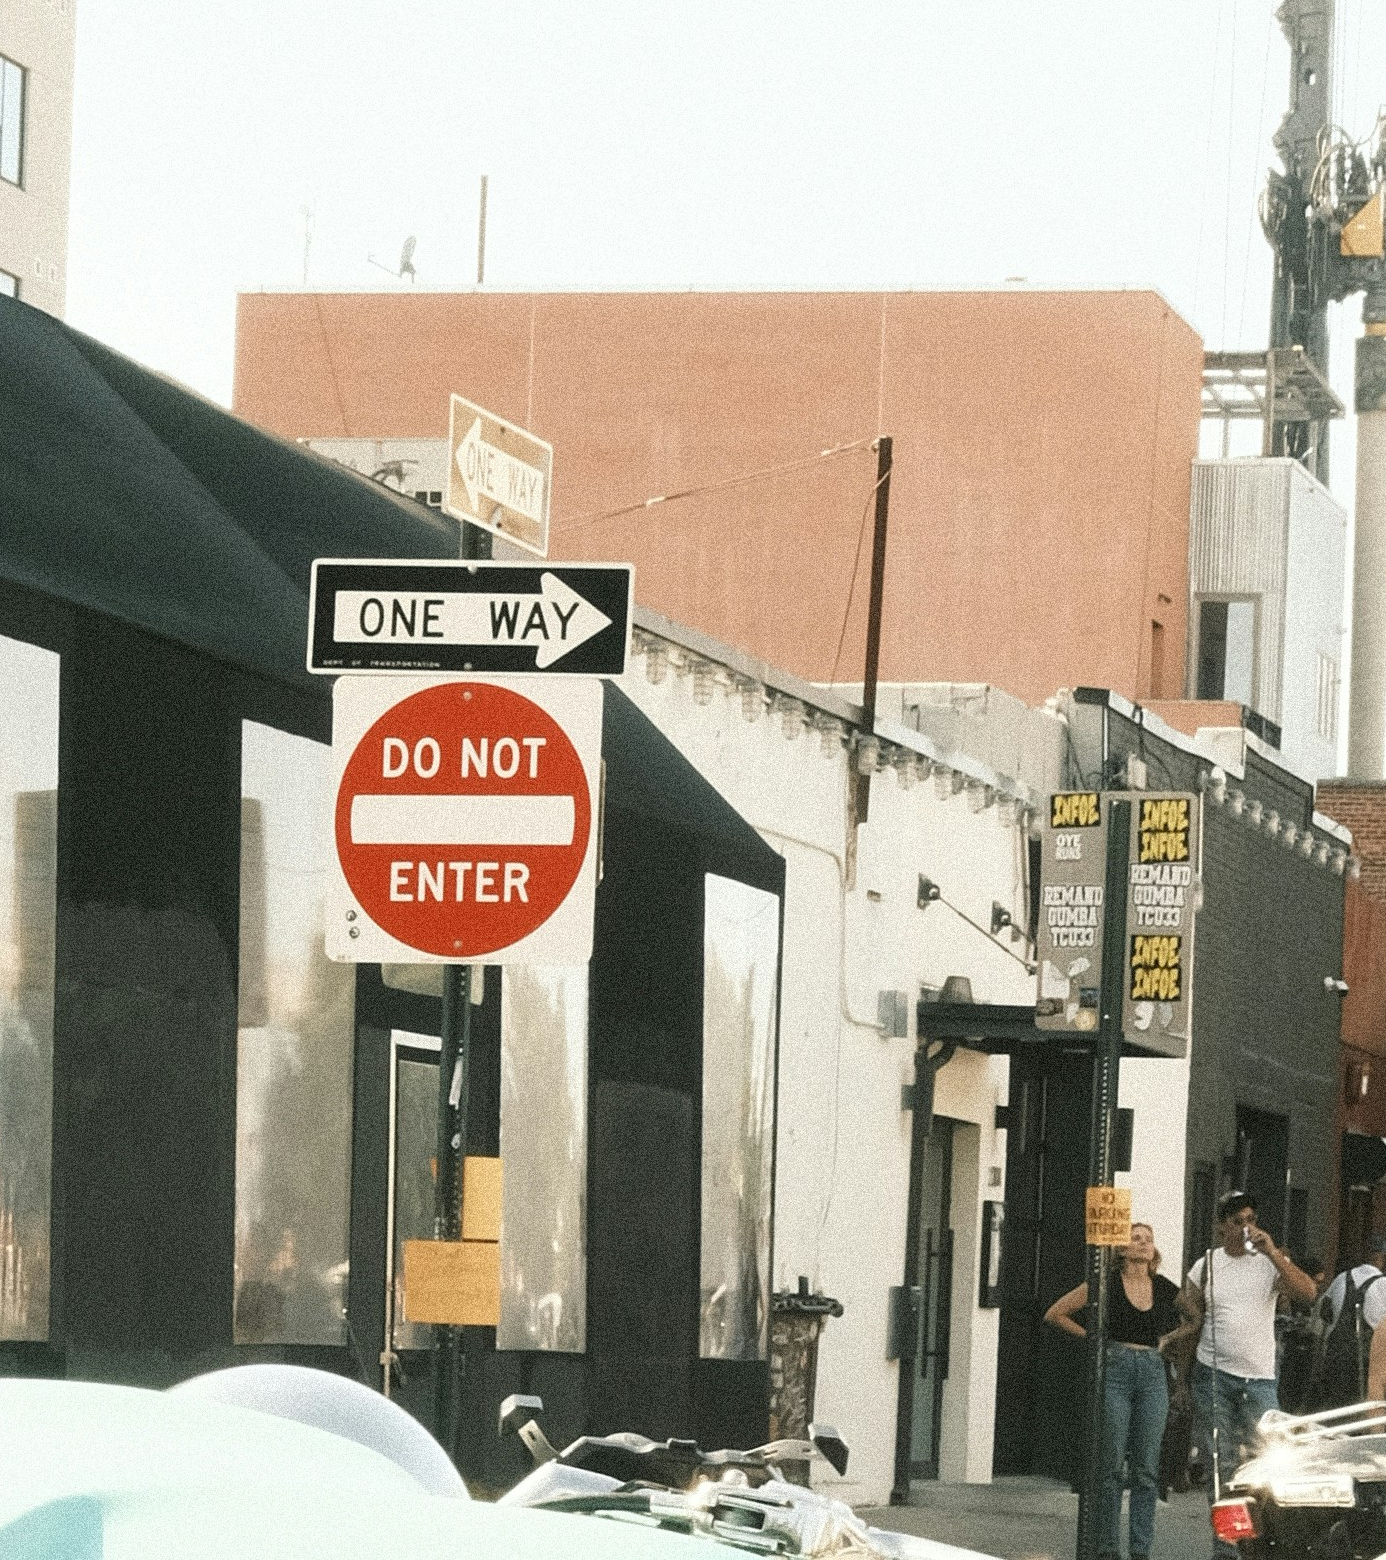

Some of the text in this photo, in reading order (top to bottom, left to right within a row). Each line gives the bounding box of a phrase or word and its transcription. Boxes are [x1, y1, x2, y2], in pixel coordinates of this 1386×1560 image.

[466, 441, 538, 508] ONE WAY
[359, 597, 580, 641] ONE WAY
[382, 737, 547, 779] DO NOT
[389, 861, 531, 904] ENTER
